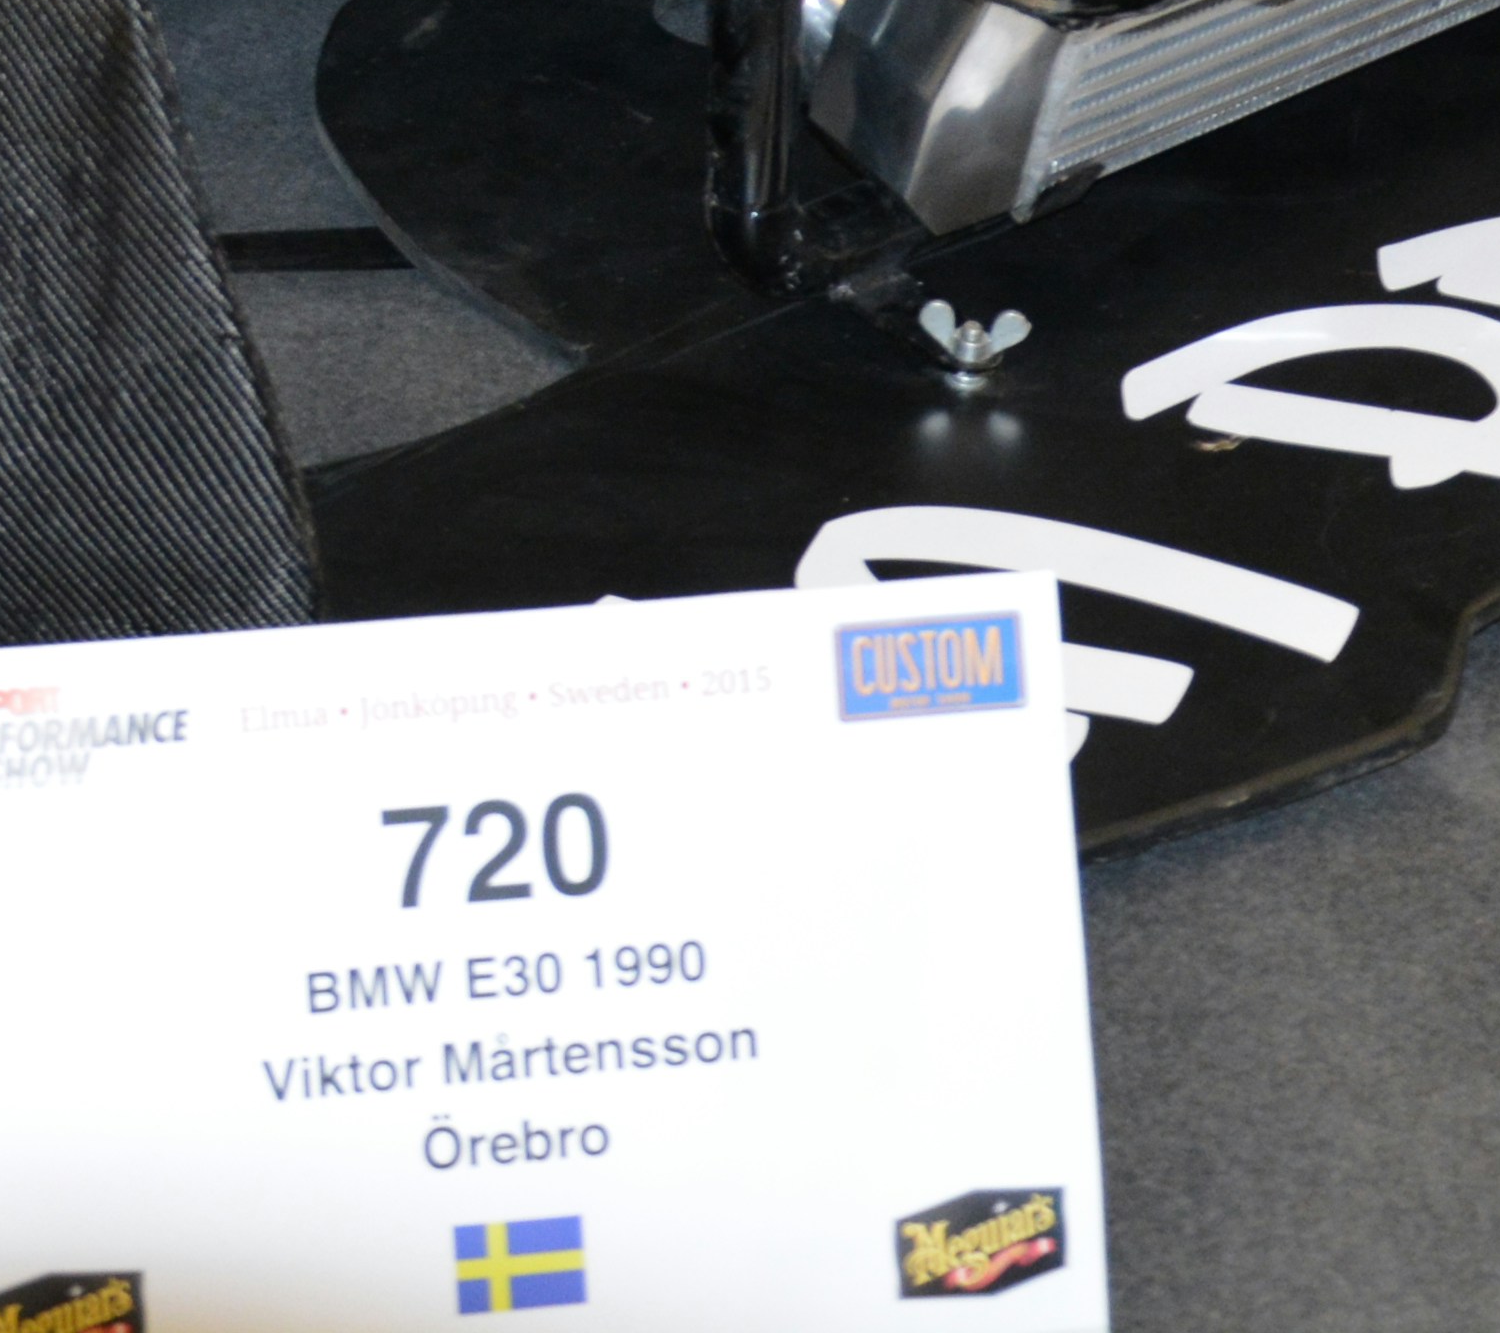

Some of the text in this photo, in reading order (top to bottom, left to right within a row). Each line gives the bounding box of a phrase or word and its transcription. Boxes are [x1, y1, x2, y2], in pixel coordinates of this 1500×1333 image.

[547, 675, 671, 708] Sweden
[700, 665, 773, 698] 2015
[852, 625, 1004, 697] CUSTOM
[380, 791, 612, 910] 720
[306, 938, 706, 1015] BMW E30 1990
[262, 1025, 760, 1101] Viktor Mårtensson
[423, 1113, 611, 1171] Örebro
